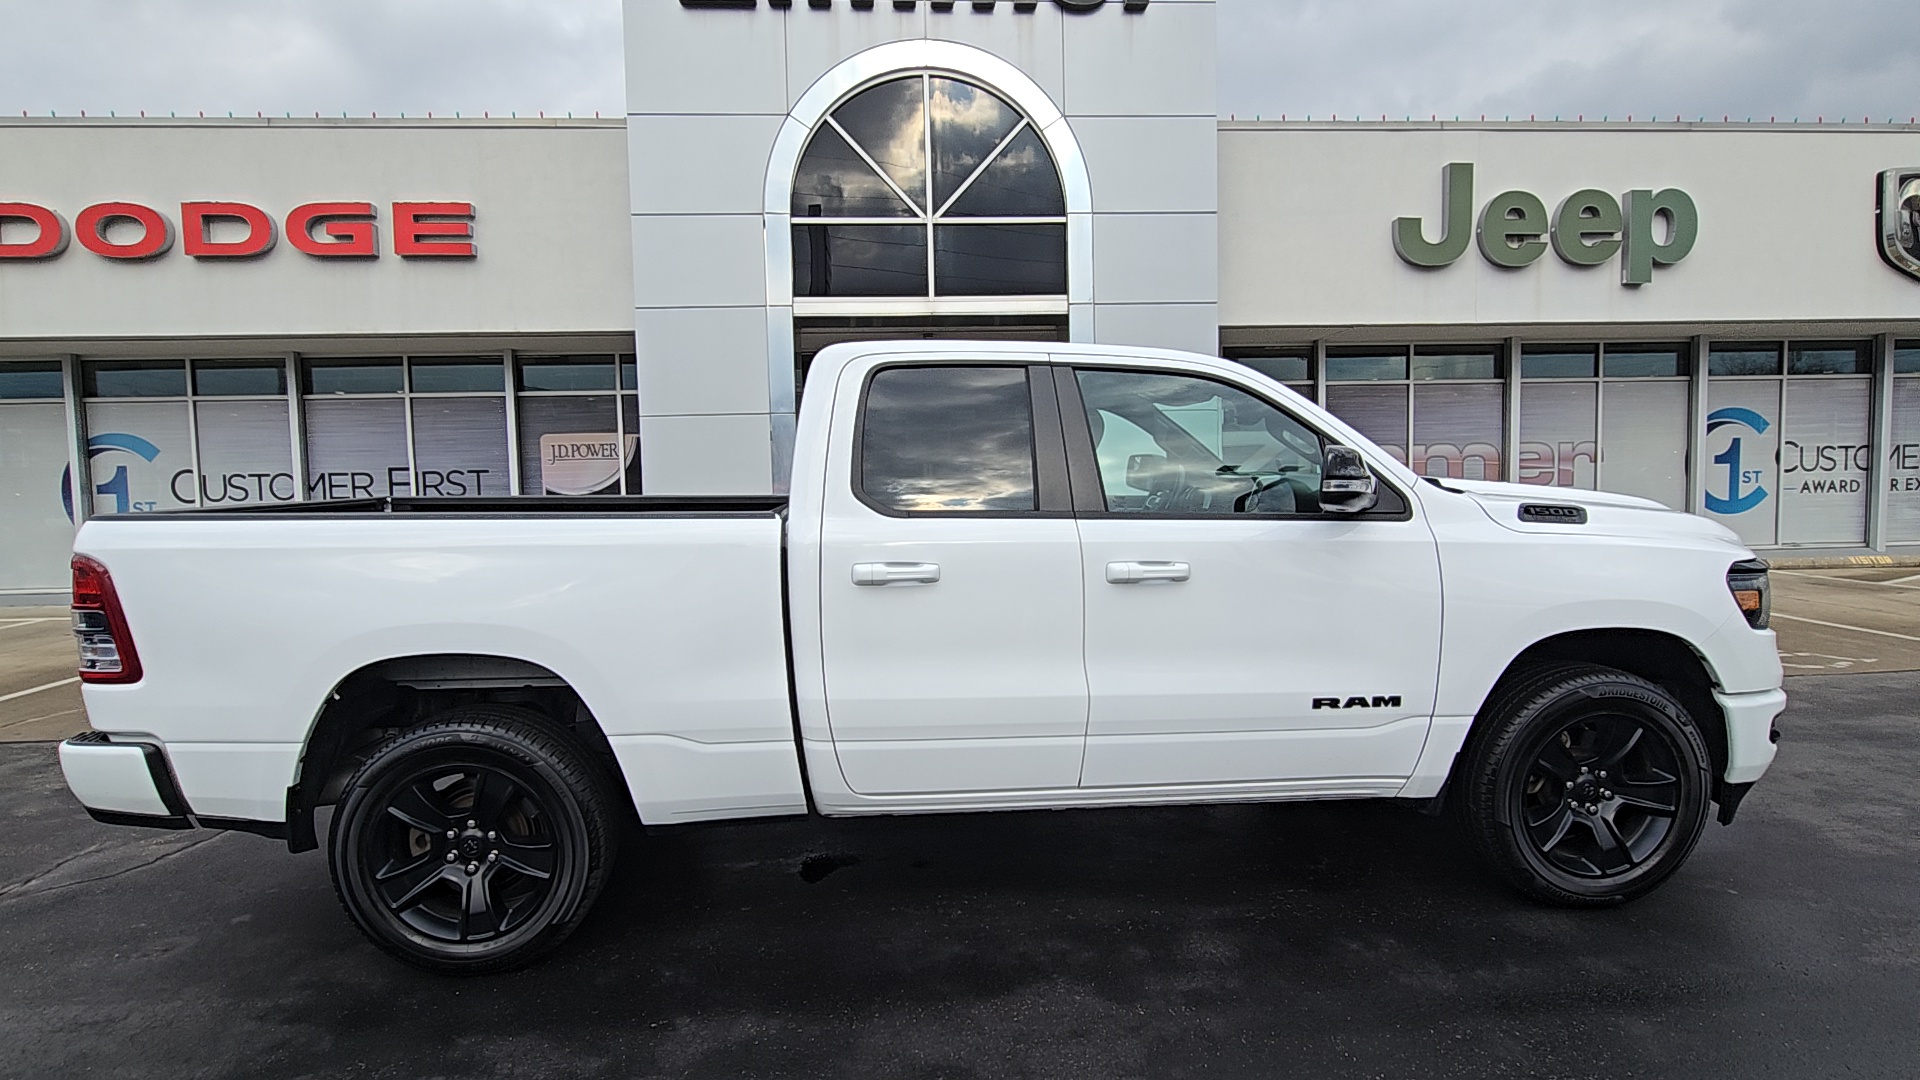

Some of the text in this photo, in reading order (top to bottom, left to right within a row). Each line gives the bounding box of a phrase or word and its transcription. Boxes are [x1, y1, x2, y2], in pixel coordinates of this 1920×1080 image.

[0, 200, 478, 260] DODGE
[1392, 161, 1698, 287] Jeep
[571, 442, 619, 459] POWER
[1377, 441, 1605, 486] mer
[388, 467, 490, 496] FIRST
[1799, 479, 1861, 494] AWARD
[1526, 506, 1579, 518] 1500
[1847, 555, 1894, 565] VISITOR
[1312, 695, 1402, 710] RAM
[1598, 687, 1670, 713] BRIDGESTONE
